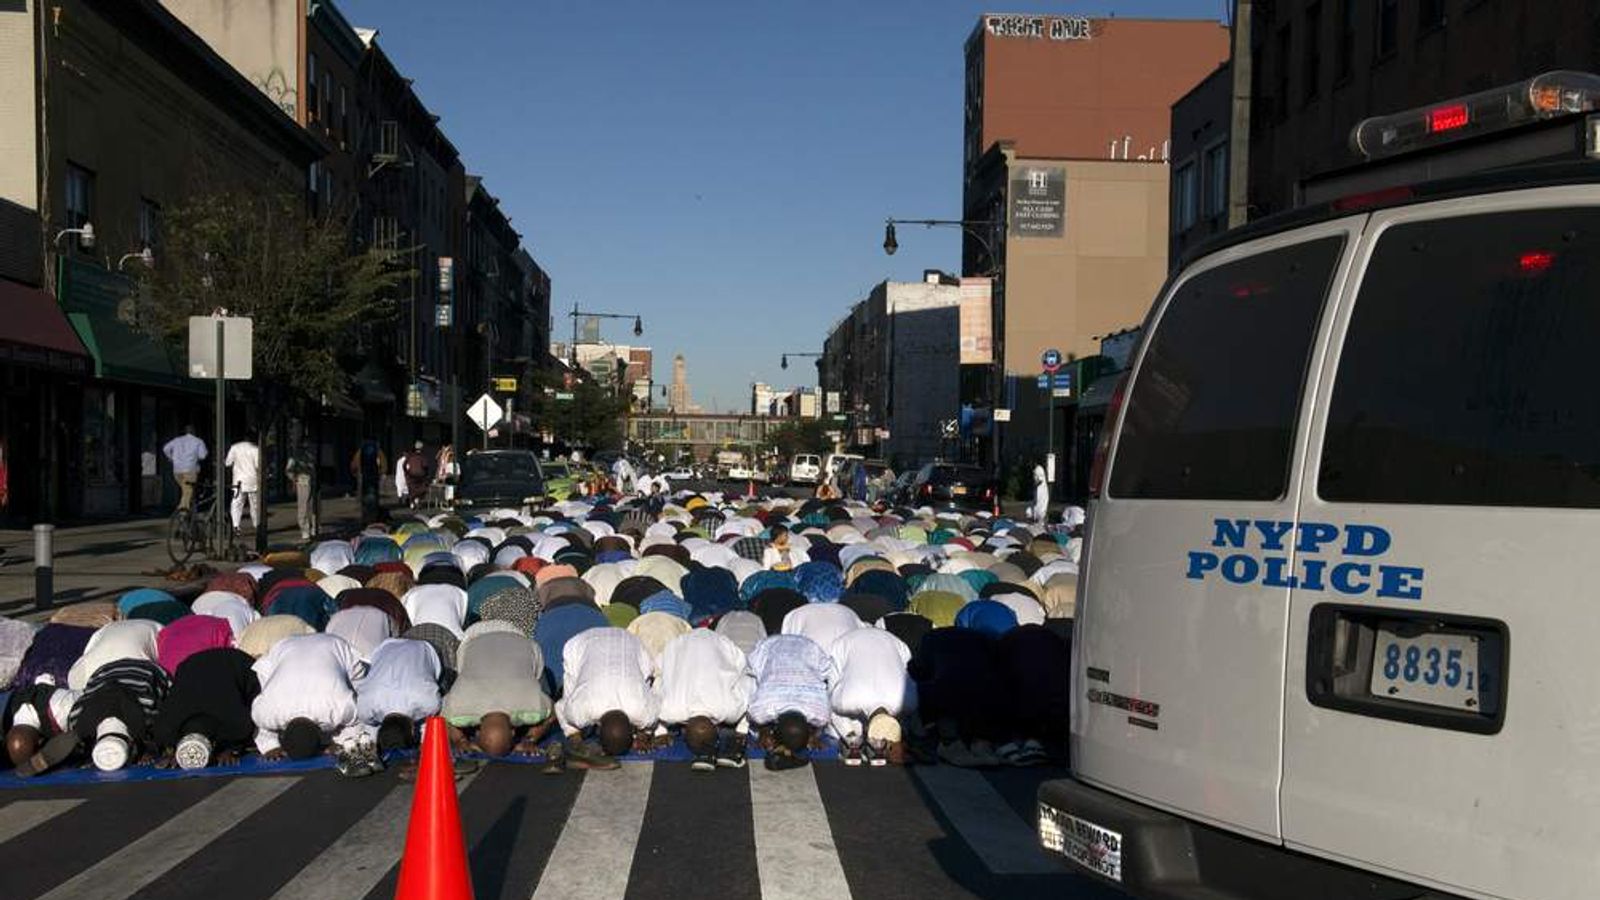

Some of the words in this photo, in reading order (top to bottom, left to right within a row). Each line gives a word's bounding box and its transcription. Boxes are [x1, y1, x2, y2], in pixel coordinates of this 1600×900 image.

[1212, 519, 1391, 556] NYPD
[1186, 551, 1424, 600] POLICE
[1384, 643, 1462, 687] 8835
[1075, 820, 1118, 852] REWARD
